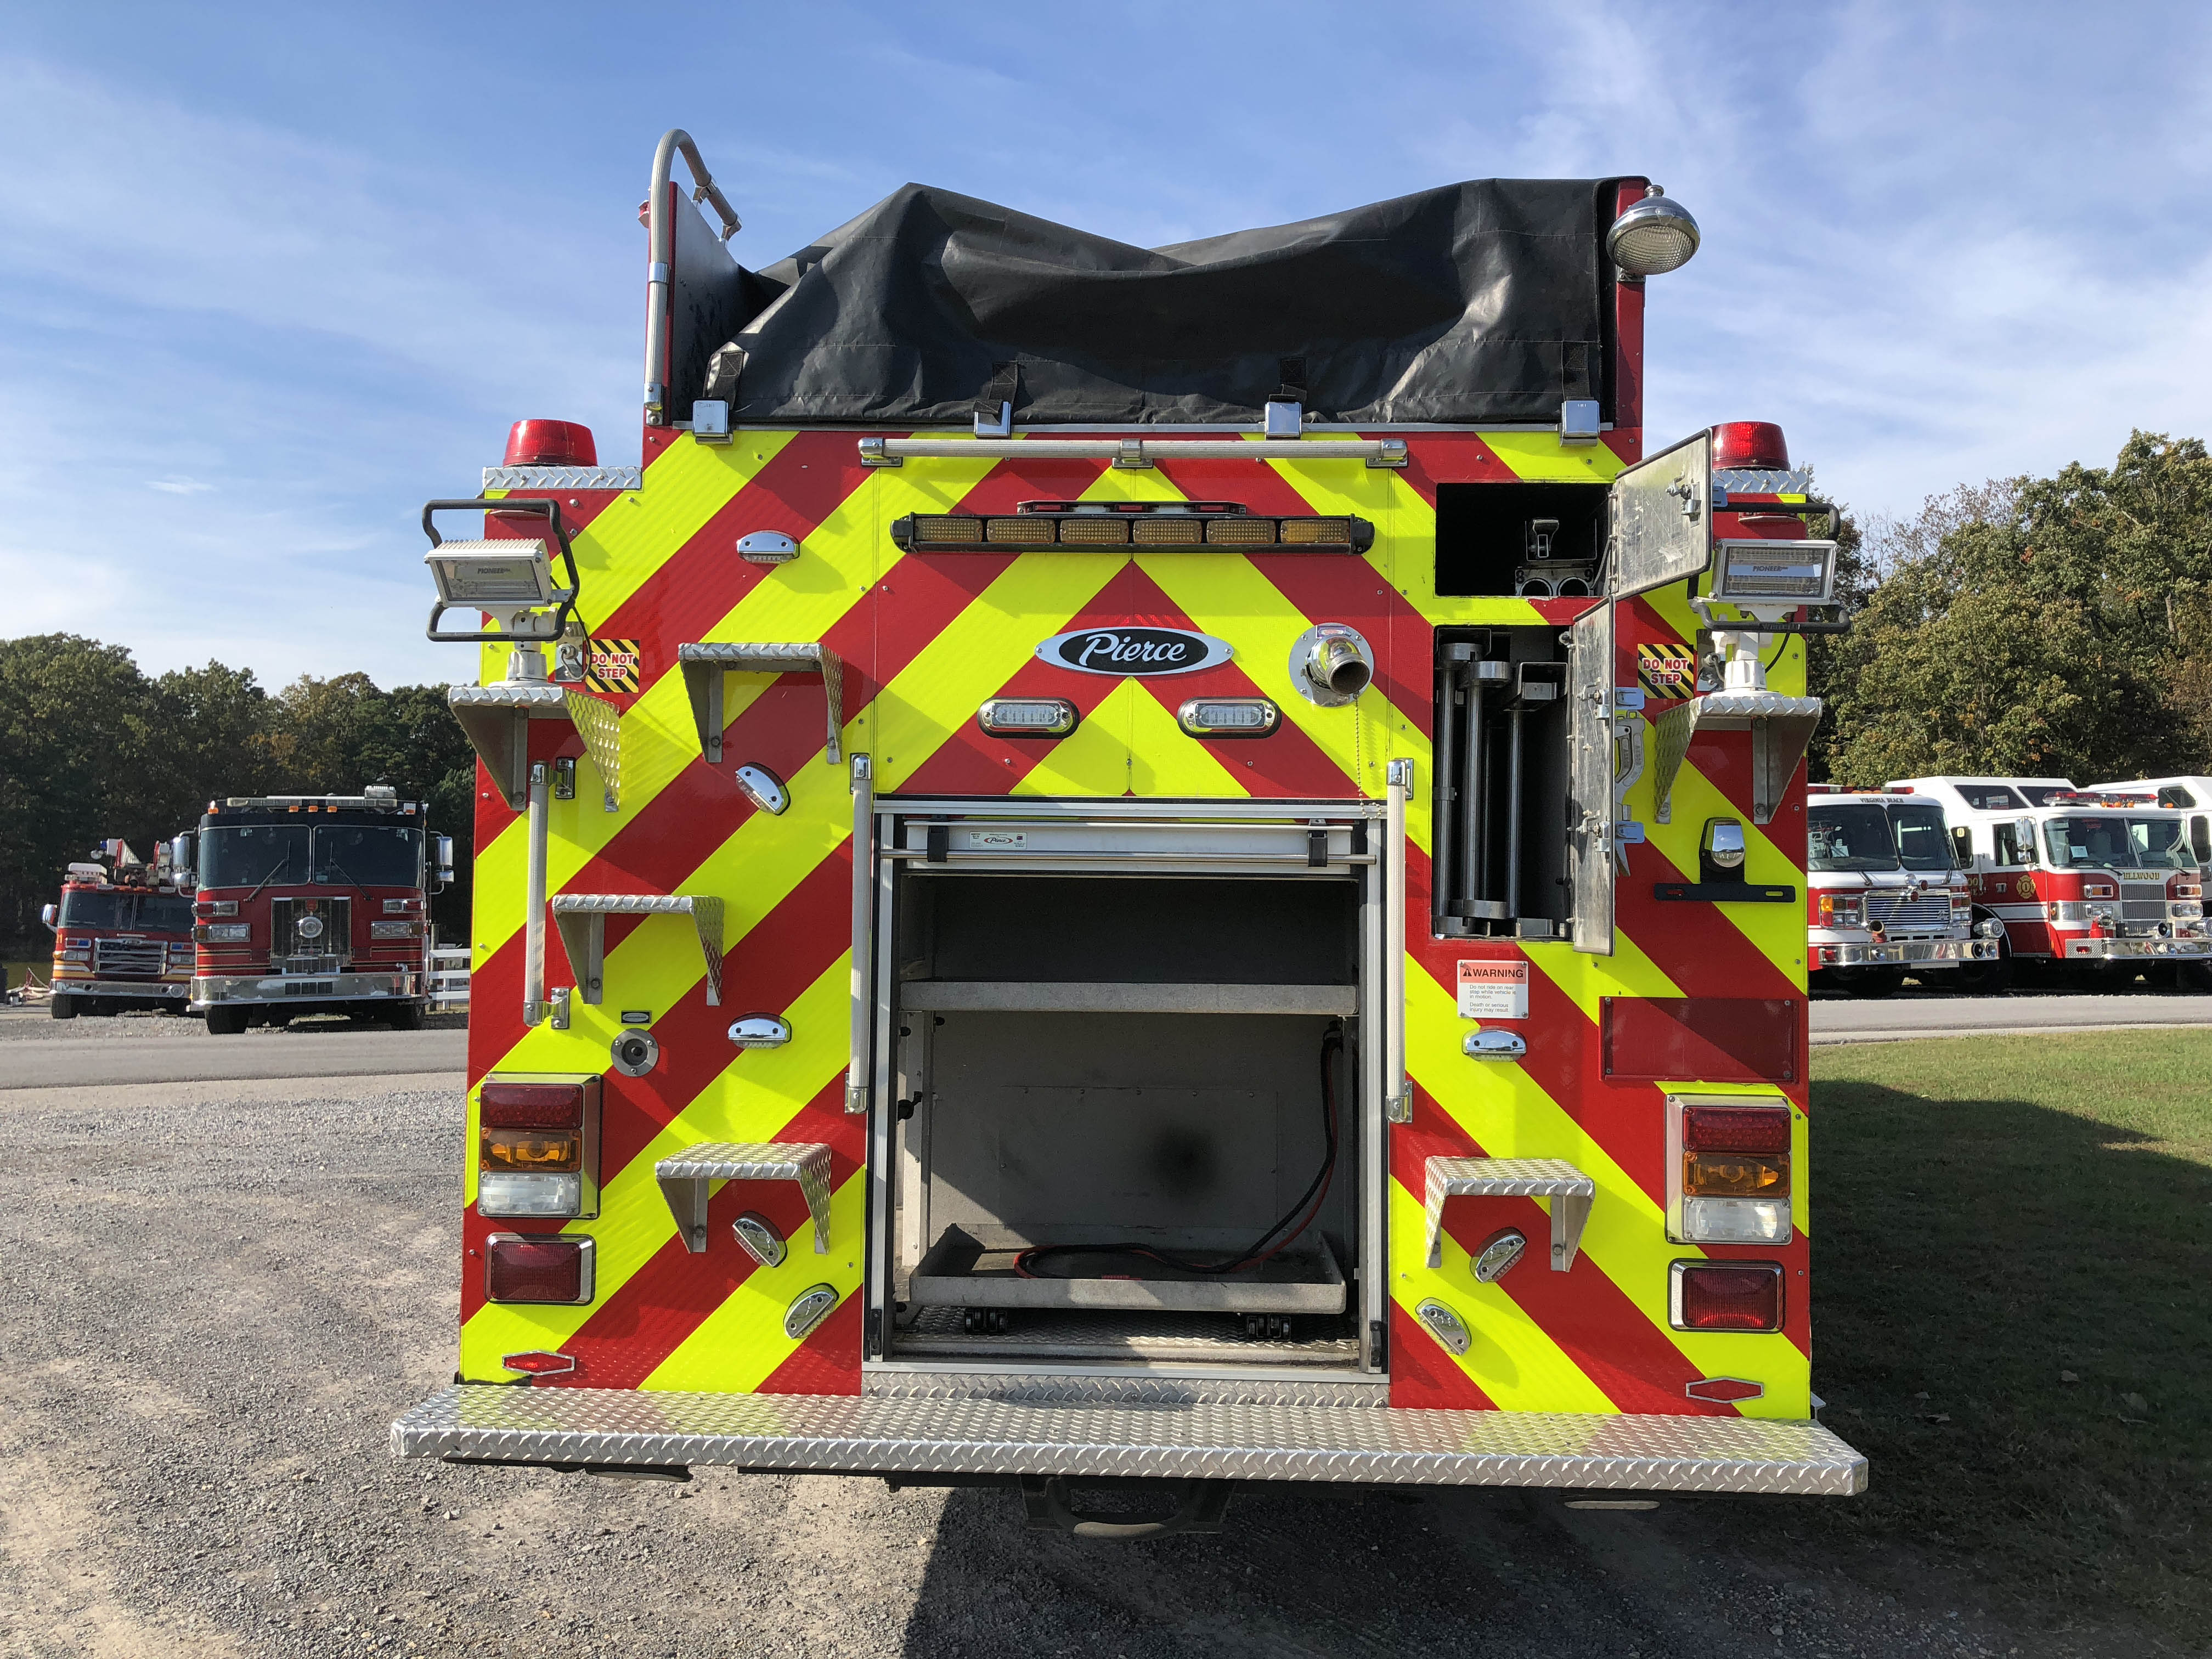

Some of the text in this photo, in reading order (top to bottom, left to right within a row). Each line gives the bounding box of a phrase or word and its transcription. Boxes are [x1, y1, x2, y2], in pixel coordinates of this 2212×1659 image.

[1516, 569, 1525, 584] 8
[1584, 568, 1593, 583] 9
[1079, 633, 1187, 666] Pierce
[592, 653, 634, 664] DO NOT
[1643, 659, 1688, 669] DO NOT
[598, 668, 627, 679] STEP
[1651, 673, 1680, 684] STEP
[1473, 968, 1523, 978] WARNING
